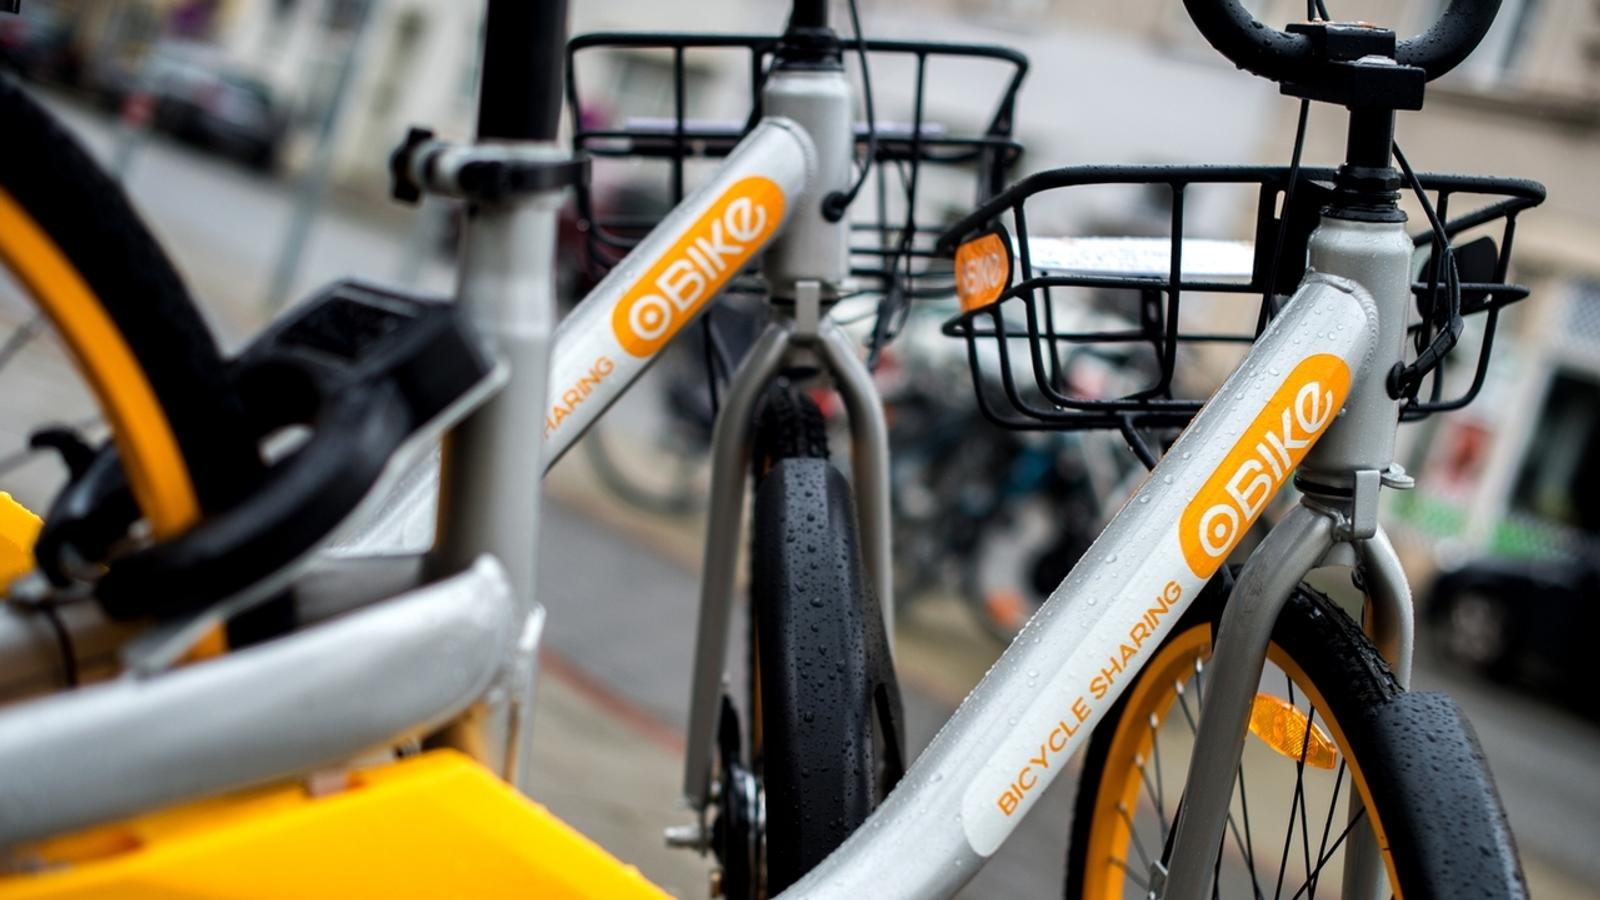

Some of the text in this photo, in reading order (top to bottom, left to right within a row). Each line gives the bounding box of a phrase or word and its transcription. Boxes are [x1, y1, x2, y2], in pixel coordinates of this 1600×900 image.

[543, 356, 614, 439] HARING
[997, 580, 1182, 816] BICYCLE SHARING
